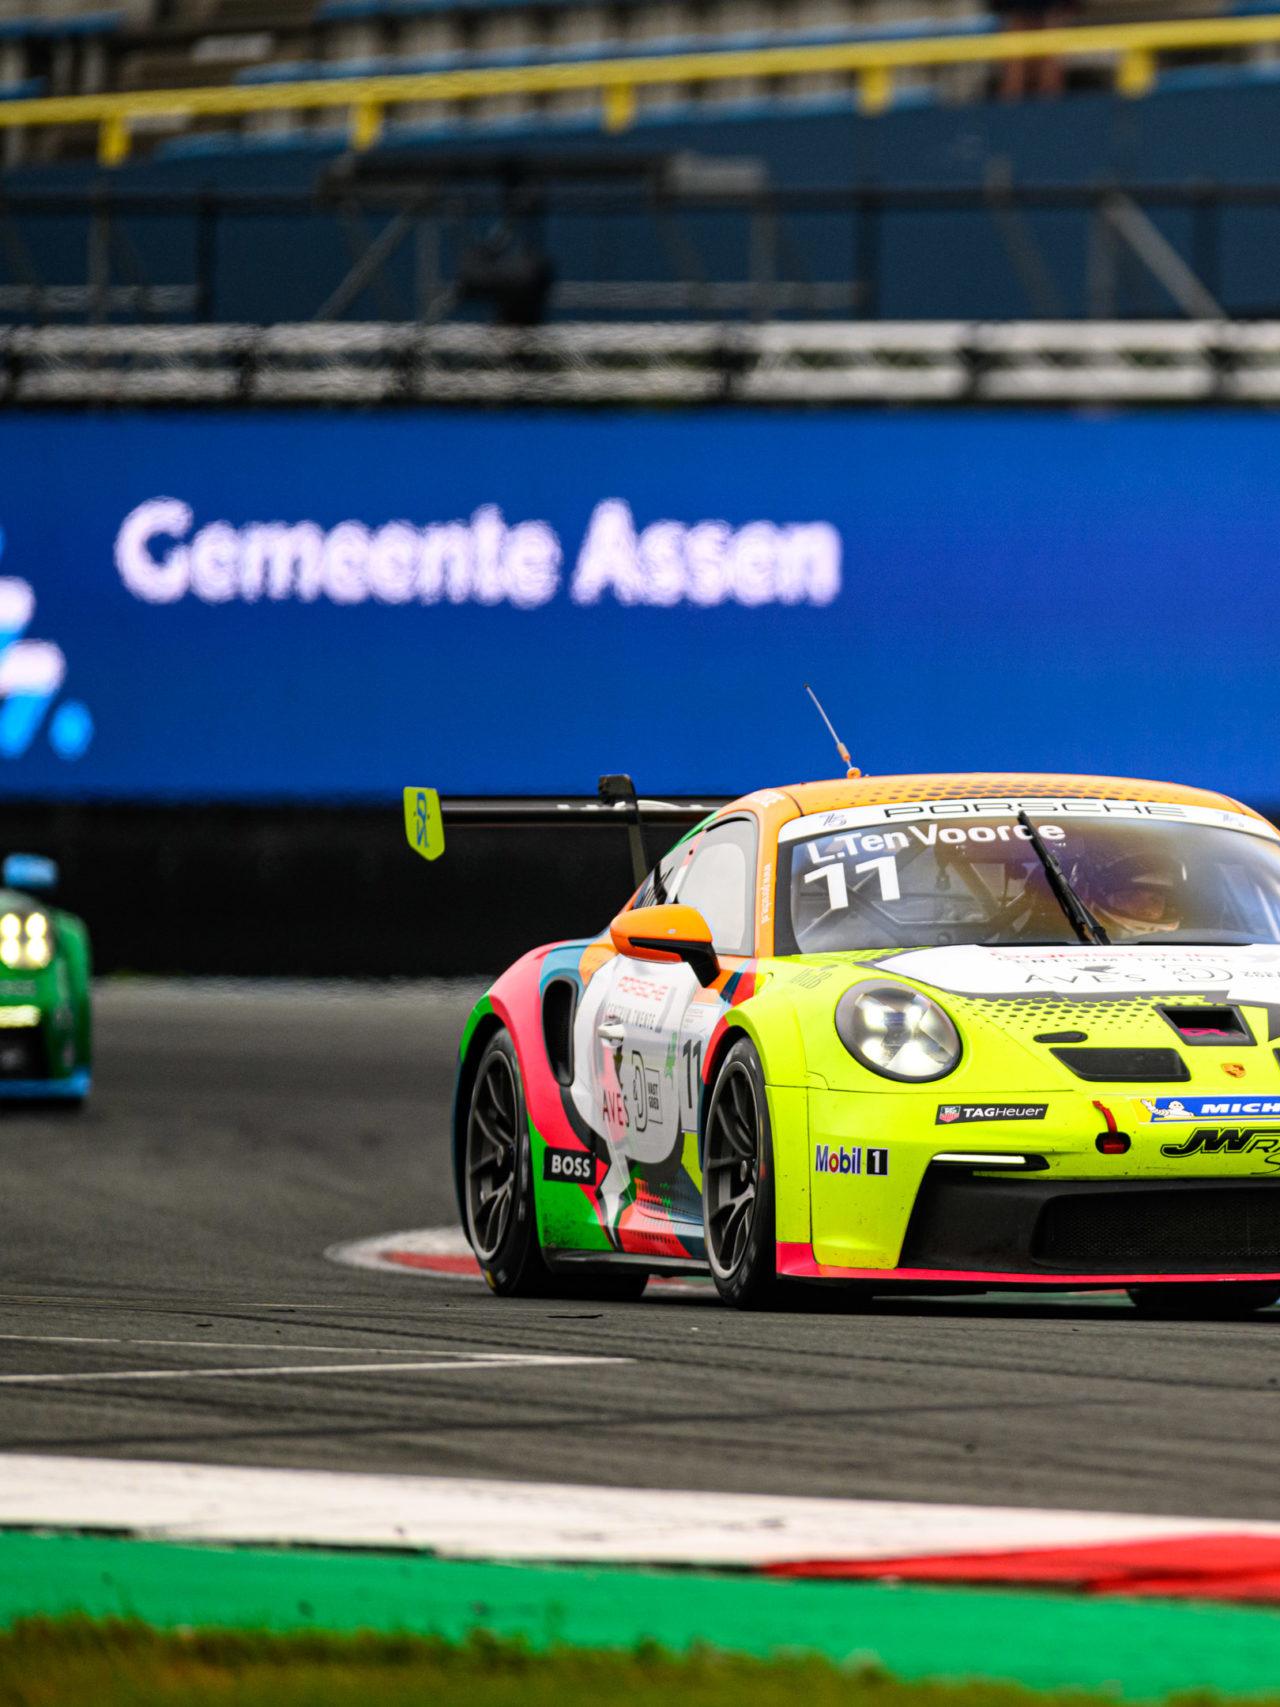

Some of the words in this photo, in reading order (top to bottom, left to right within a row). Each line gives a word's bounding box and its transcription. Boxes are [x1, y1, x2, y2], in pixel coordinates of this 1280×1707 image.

[114, 495, 562, 609] Gemeente
[571, 497, 842, 608] Assen
[884, 802, 1186, 818] PORSCHE
[804, 855, 900, 910] 11
[683, 1039, 702, 1109] 11
[603, 1089, 629, 1127] AVES
[551, 1154, 591, 1178] BOSS
[815, 1144, 862, 1174] Mobil
[872, 1150, 880, 1173] 1
